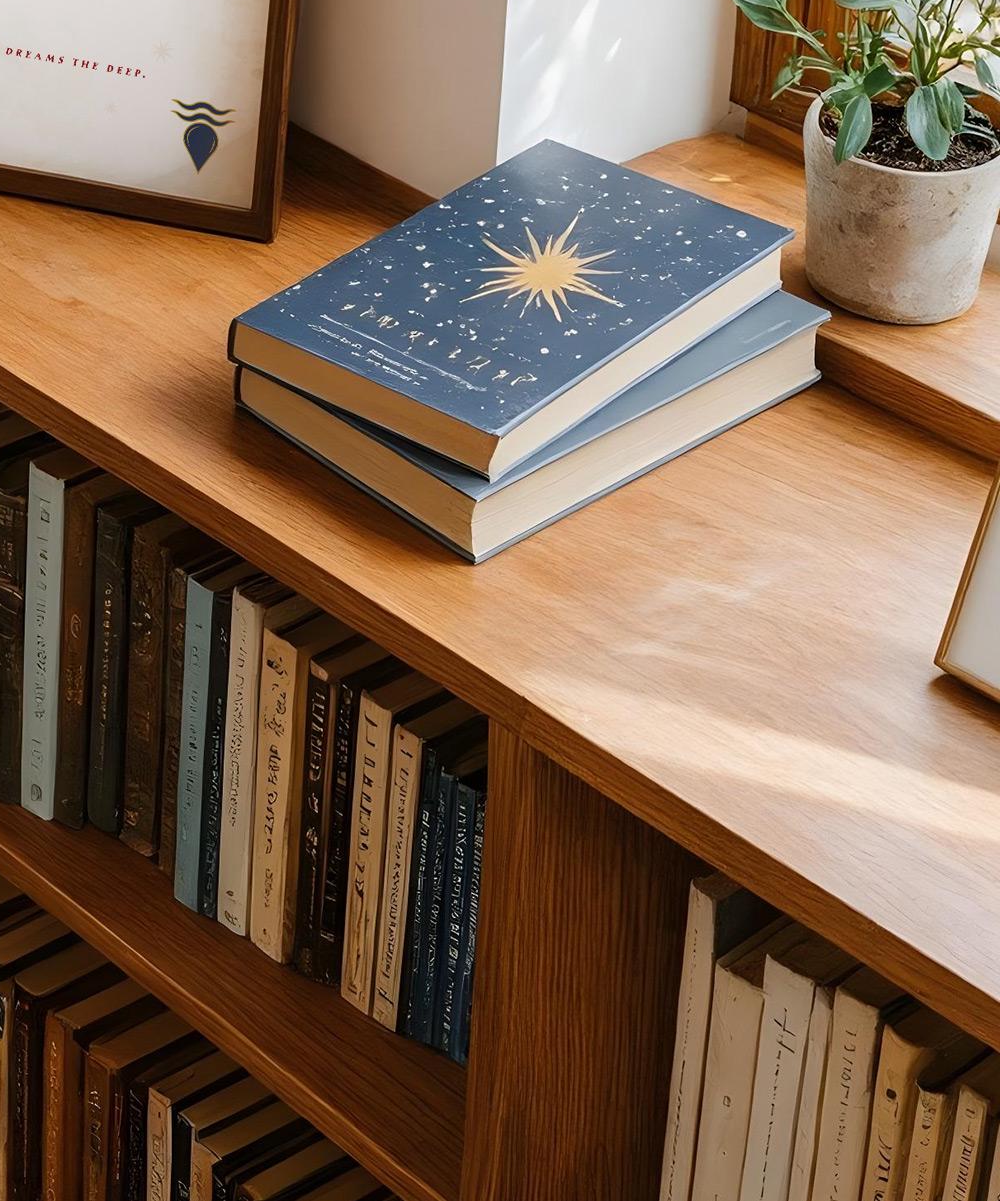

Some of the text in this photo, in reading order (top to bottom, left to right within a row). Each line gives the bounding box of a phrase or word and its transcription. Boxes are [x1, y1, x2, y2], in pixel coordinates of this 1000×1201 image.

[5, 47, 65, 65] DREAMS
[71, 57, 99, 71] THE
[106, 64, 146, 79] DEEP.
